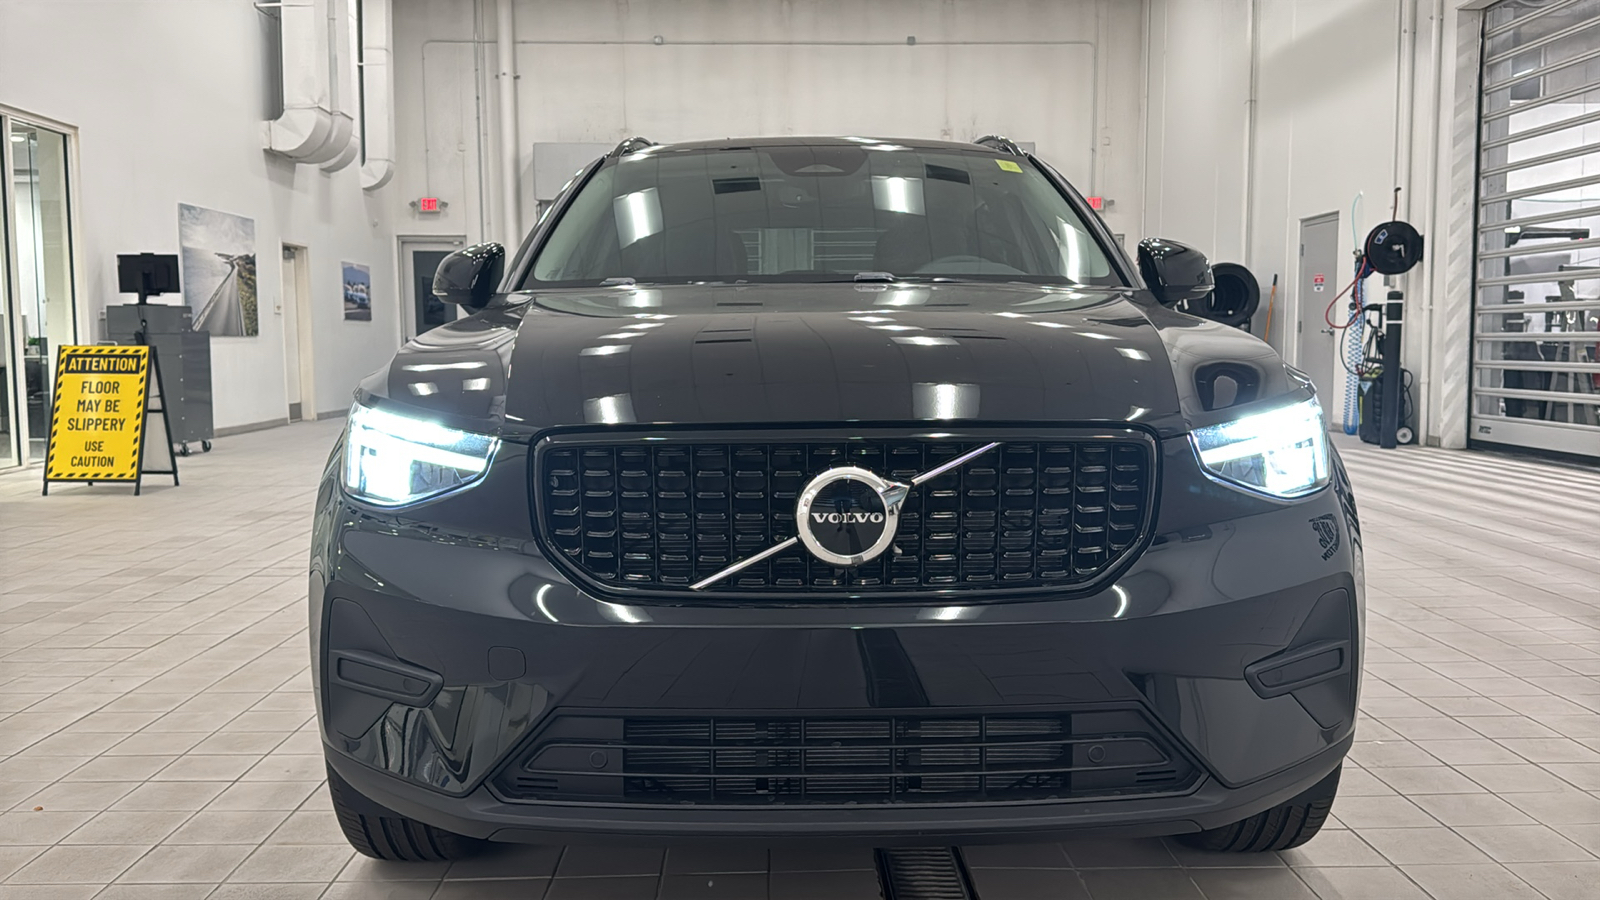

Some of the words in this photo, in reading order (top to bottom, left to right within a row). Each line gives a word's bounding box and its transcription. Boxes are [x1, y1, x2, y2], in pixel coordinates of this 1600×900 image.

[421, 198, 437, 210] EXIT
[68, 357, 137, 371] ATTENTION
[81, 381, 120, 394] FLOOR
[76, 400, 102, 413] MAY
[104, 400, 121, 412] BE
[67, 418, 126, 431] SLIPPERY
[84, 441, 104, 452] USE
[70, 456, 115, 467] CAUTION
[811, 512, 884, 524] VOLVO
